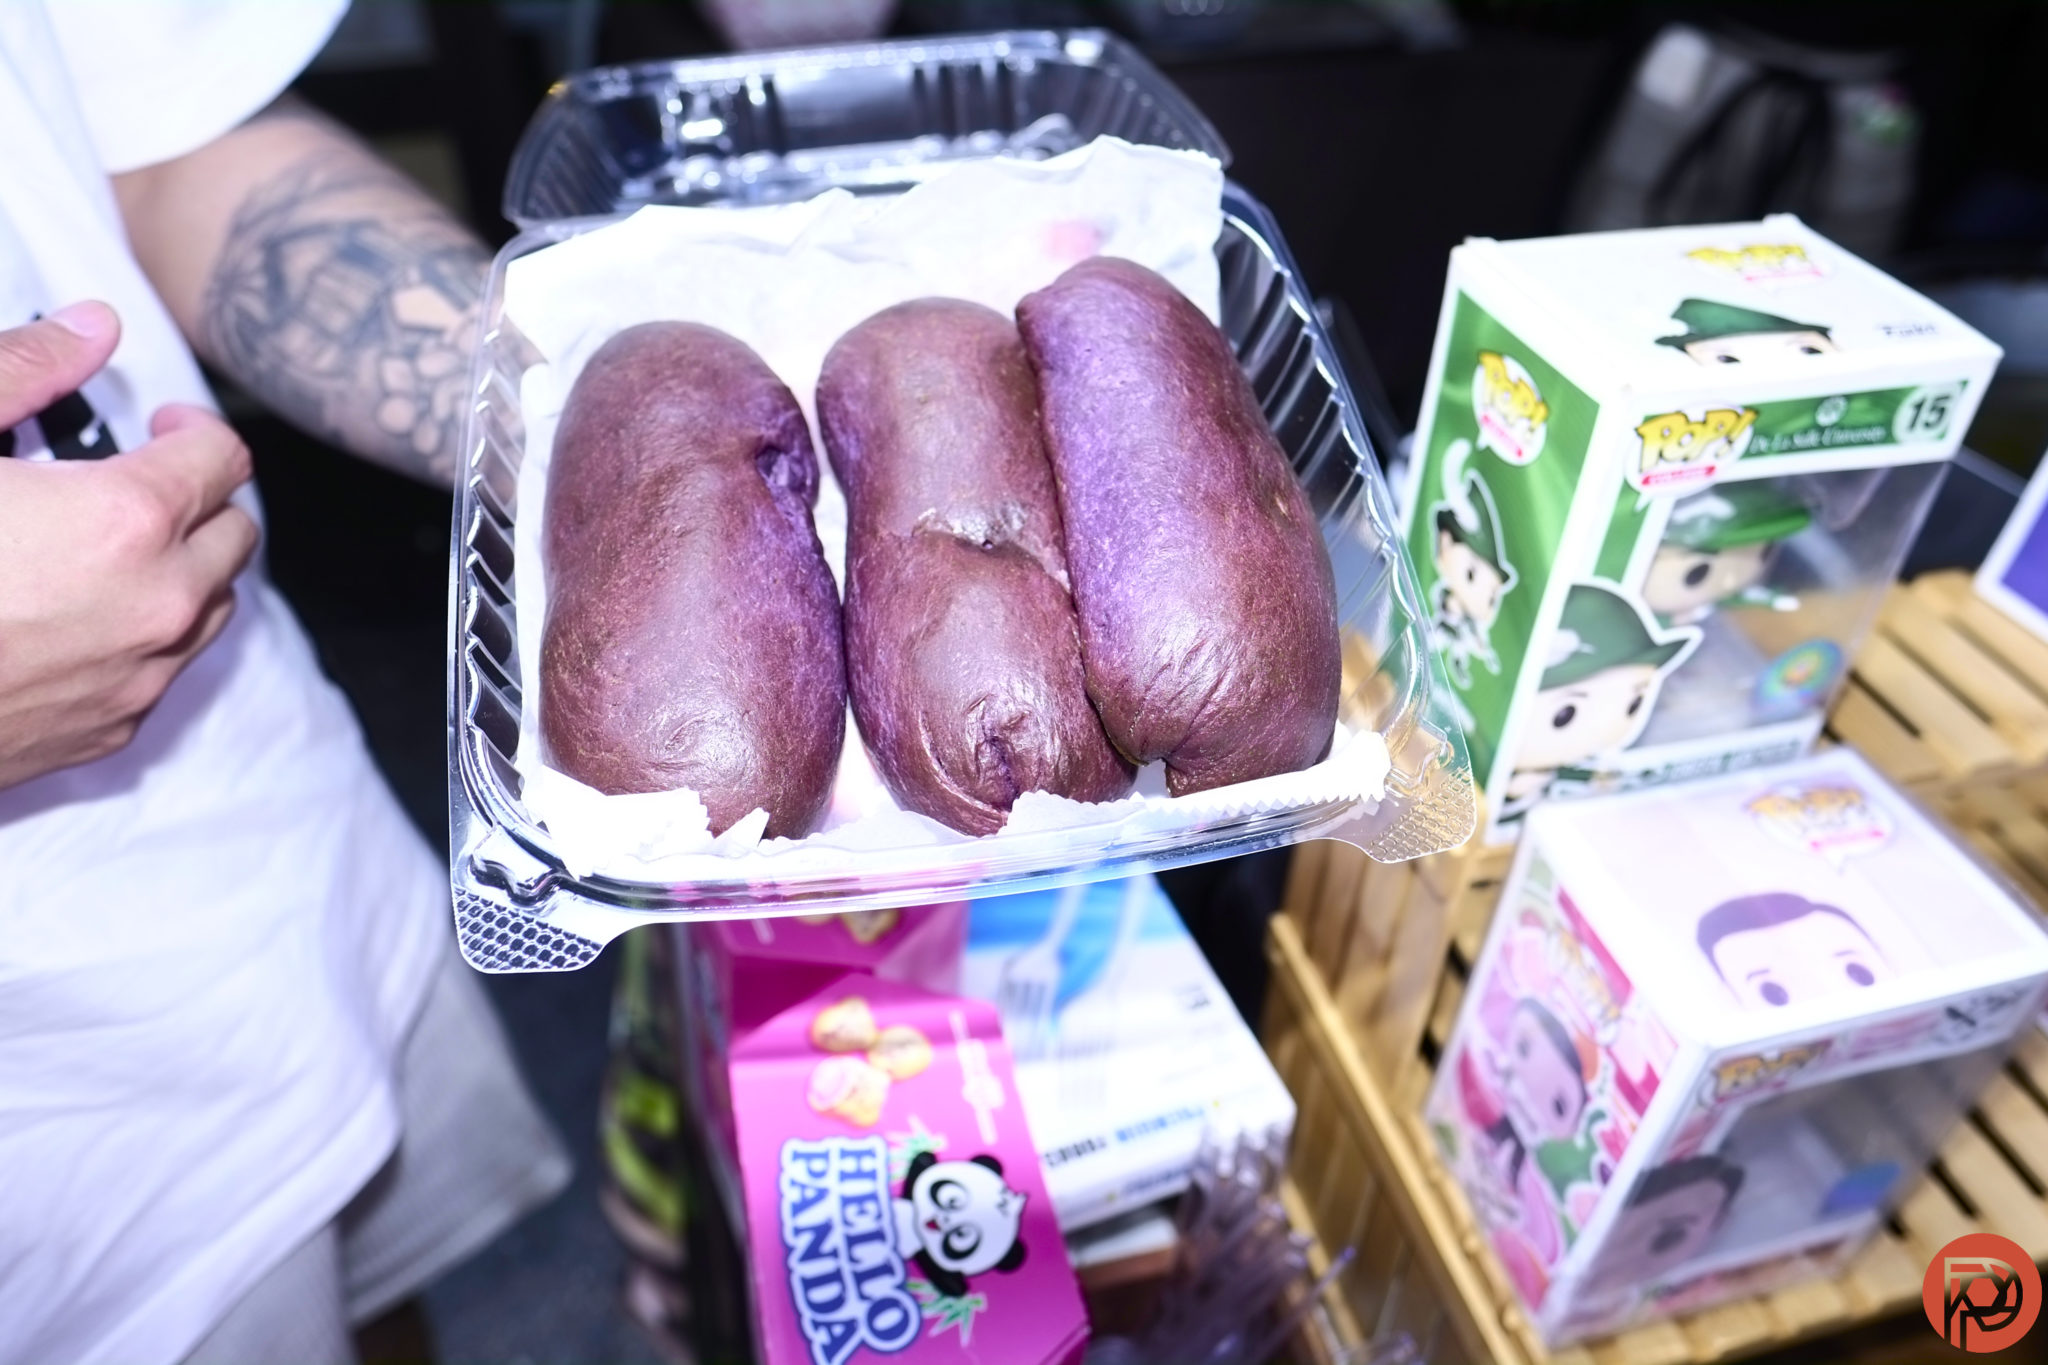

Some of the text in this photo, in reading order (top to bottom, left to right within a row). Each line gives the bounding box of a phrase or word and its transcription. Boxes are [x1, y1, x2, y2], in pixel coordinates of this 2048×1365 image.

[1635, 407, 1759, 473] POP!
[1904, 394, 1954, 432] 15
[789, 1149, 859, 1365] PANDA
[838, 1147, 911, 1342] HELLO
